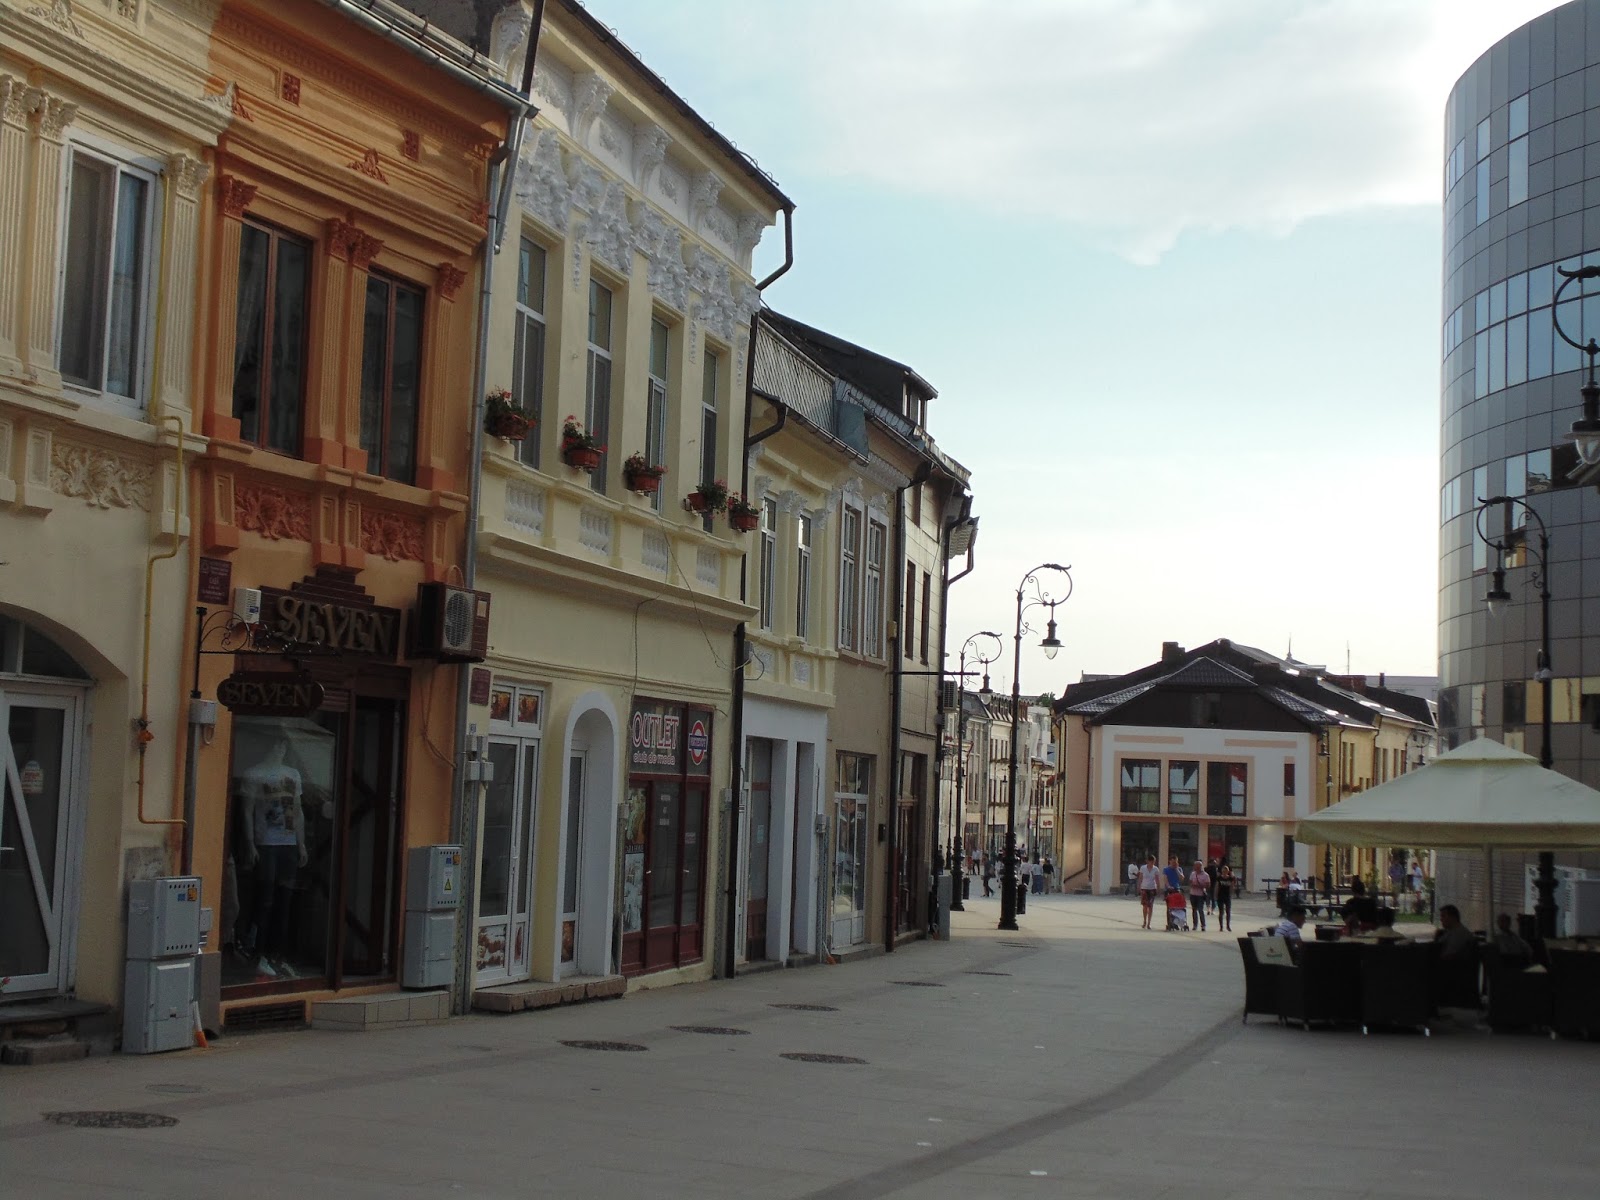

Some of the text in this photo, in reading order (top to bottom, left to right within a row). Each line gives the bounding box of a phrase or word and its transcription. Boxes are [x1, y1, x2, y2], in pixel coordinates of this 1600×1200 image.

[271, 595, 395, 655] SEVEN
[224, 680, 315, 708] SEVEN
[632, 711, 680, 750] OUTLET
[633, 750, 648, 763] club
[648, 751, 658, 764] de
